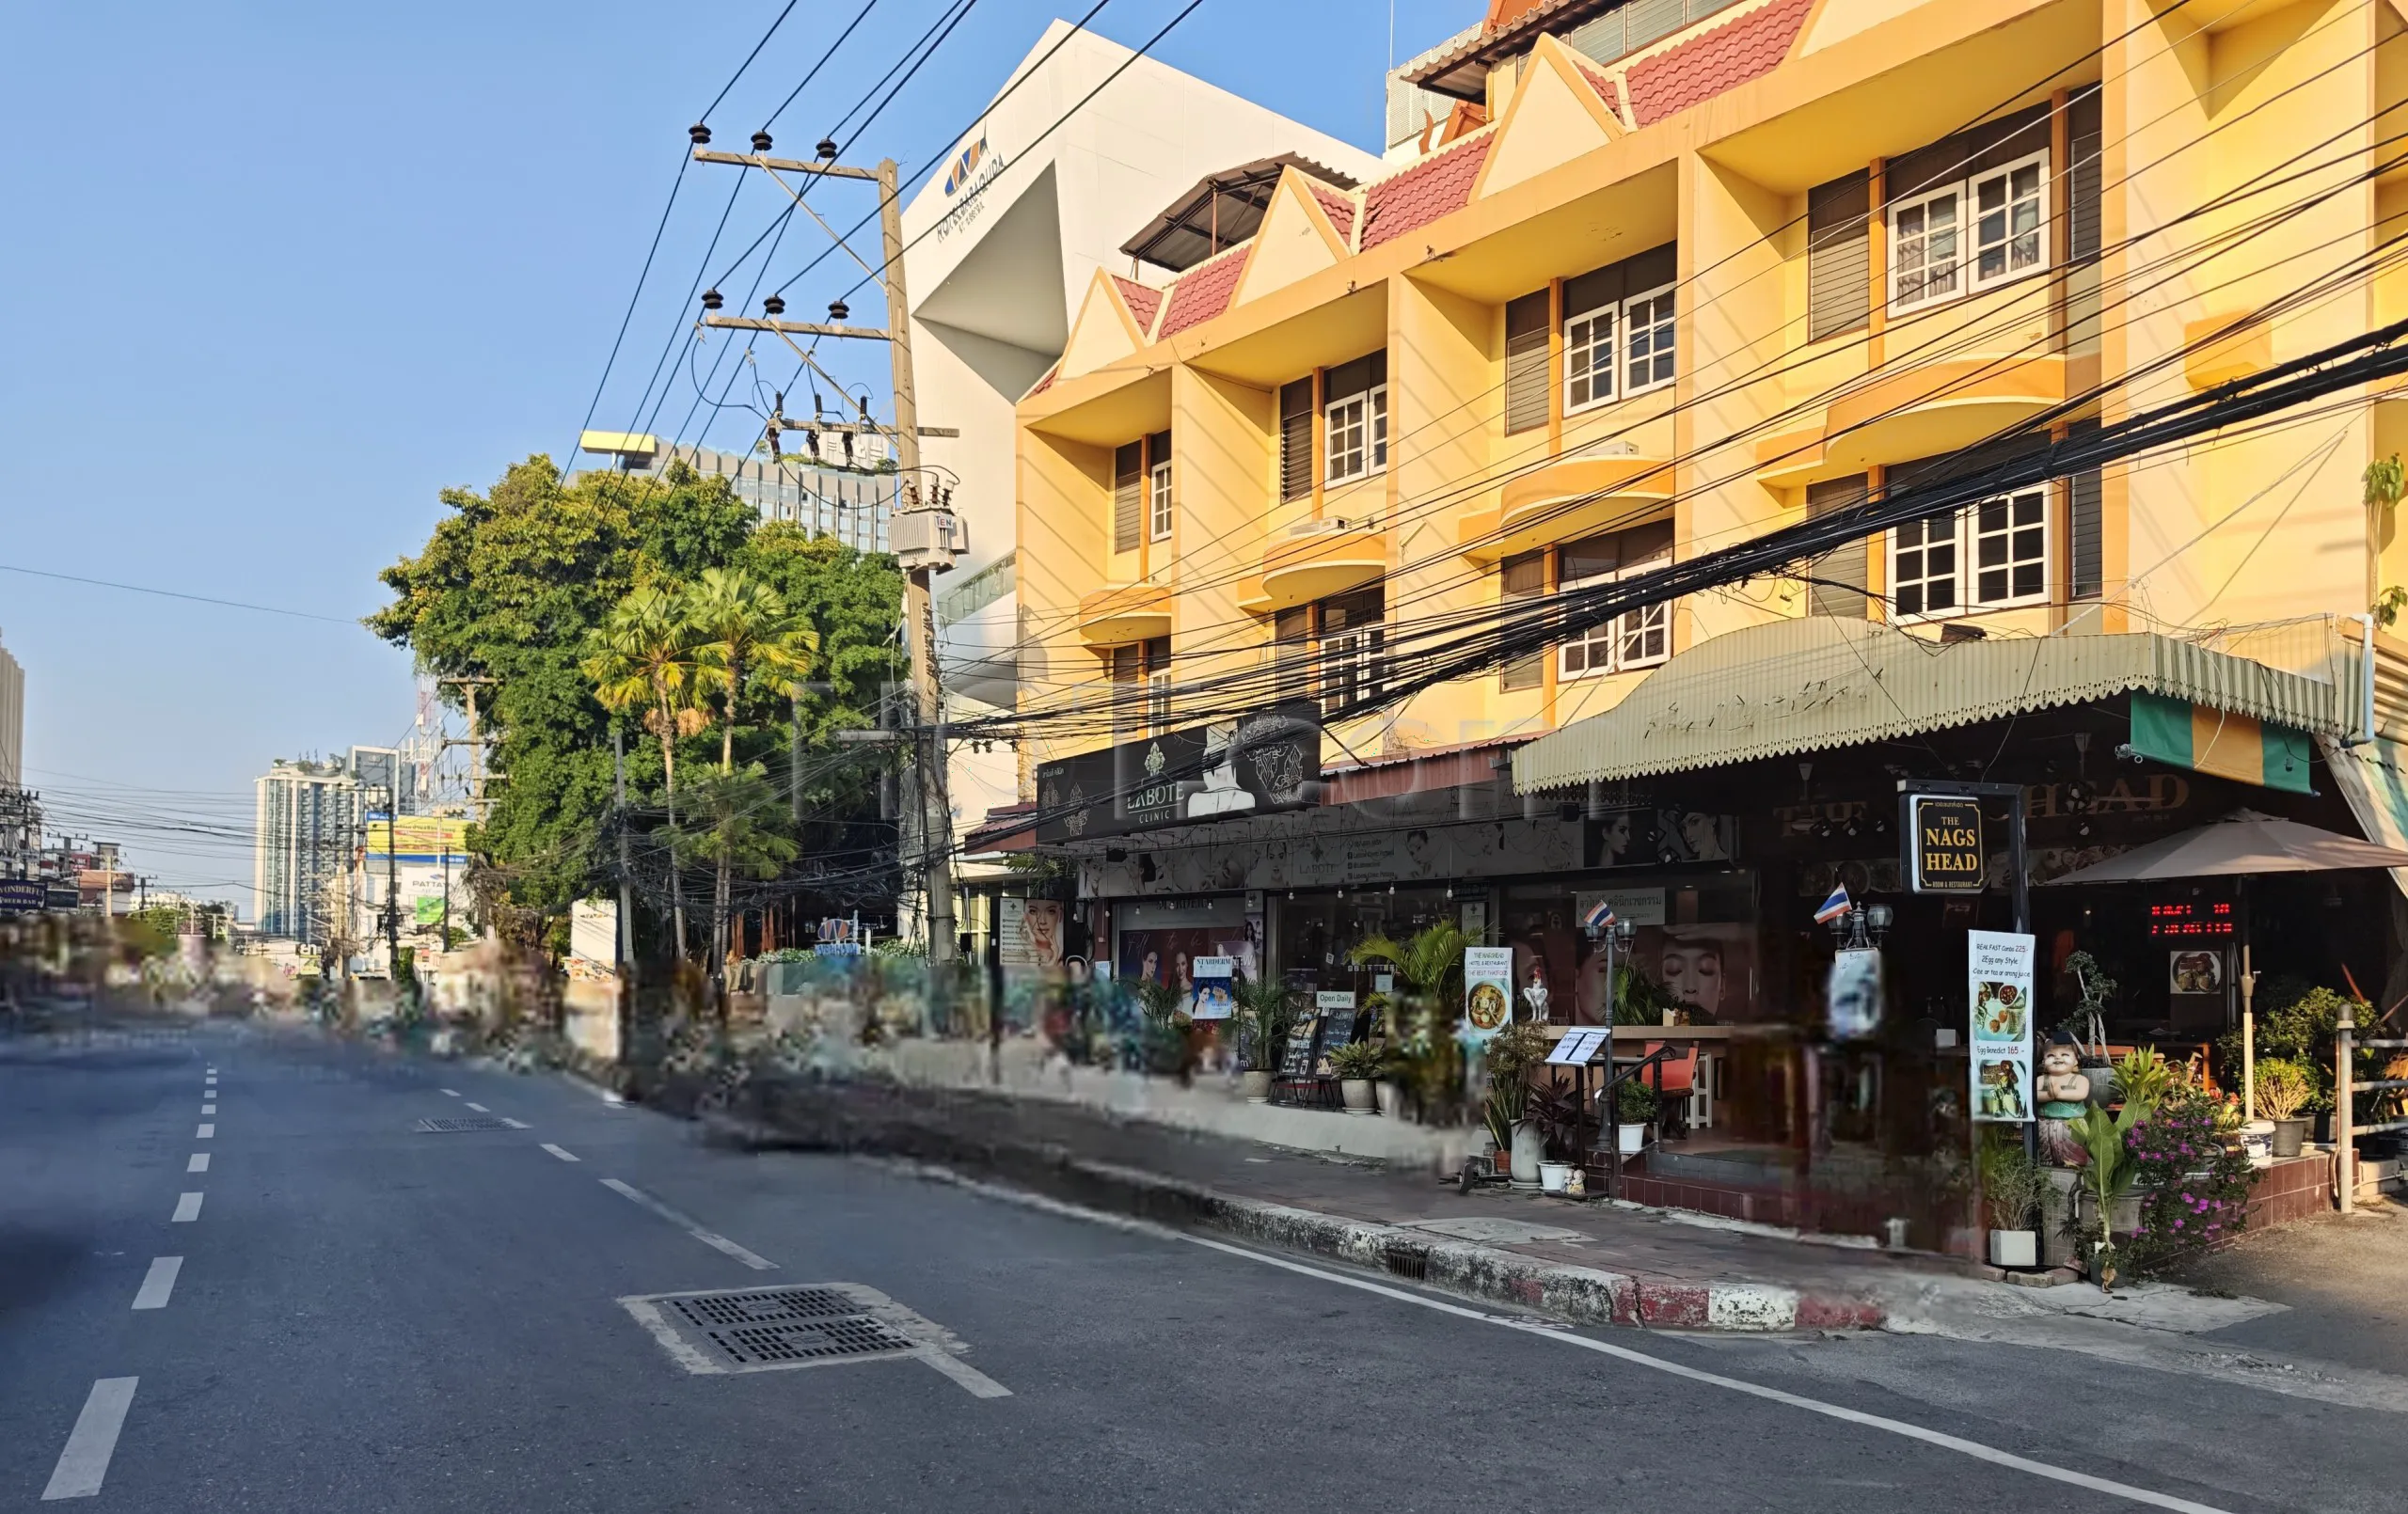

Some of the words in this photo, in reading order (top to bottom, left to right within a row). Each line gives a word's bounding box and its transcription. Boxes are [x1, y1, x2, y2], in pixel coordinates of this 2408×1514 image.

[1139, 810, 1170, 824] CLINIC
[1941, 816, 1960, 826] THE
[1925, 828, 1976, 847] NAGS
[1925, 853, 1978, 872] HEAD
[1948, 880, 1973, 889] RESTAURANT
[2004, 957, 2019, 966] Style
[1320, 994, 1336, 1003] Open
[1337, 994, 1352, 1003] Daily
[1977, 1046, 1987, 1055] Egg
[1987, 1046, 2006, 1054] Benedict
